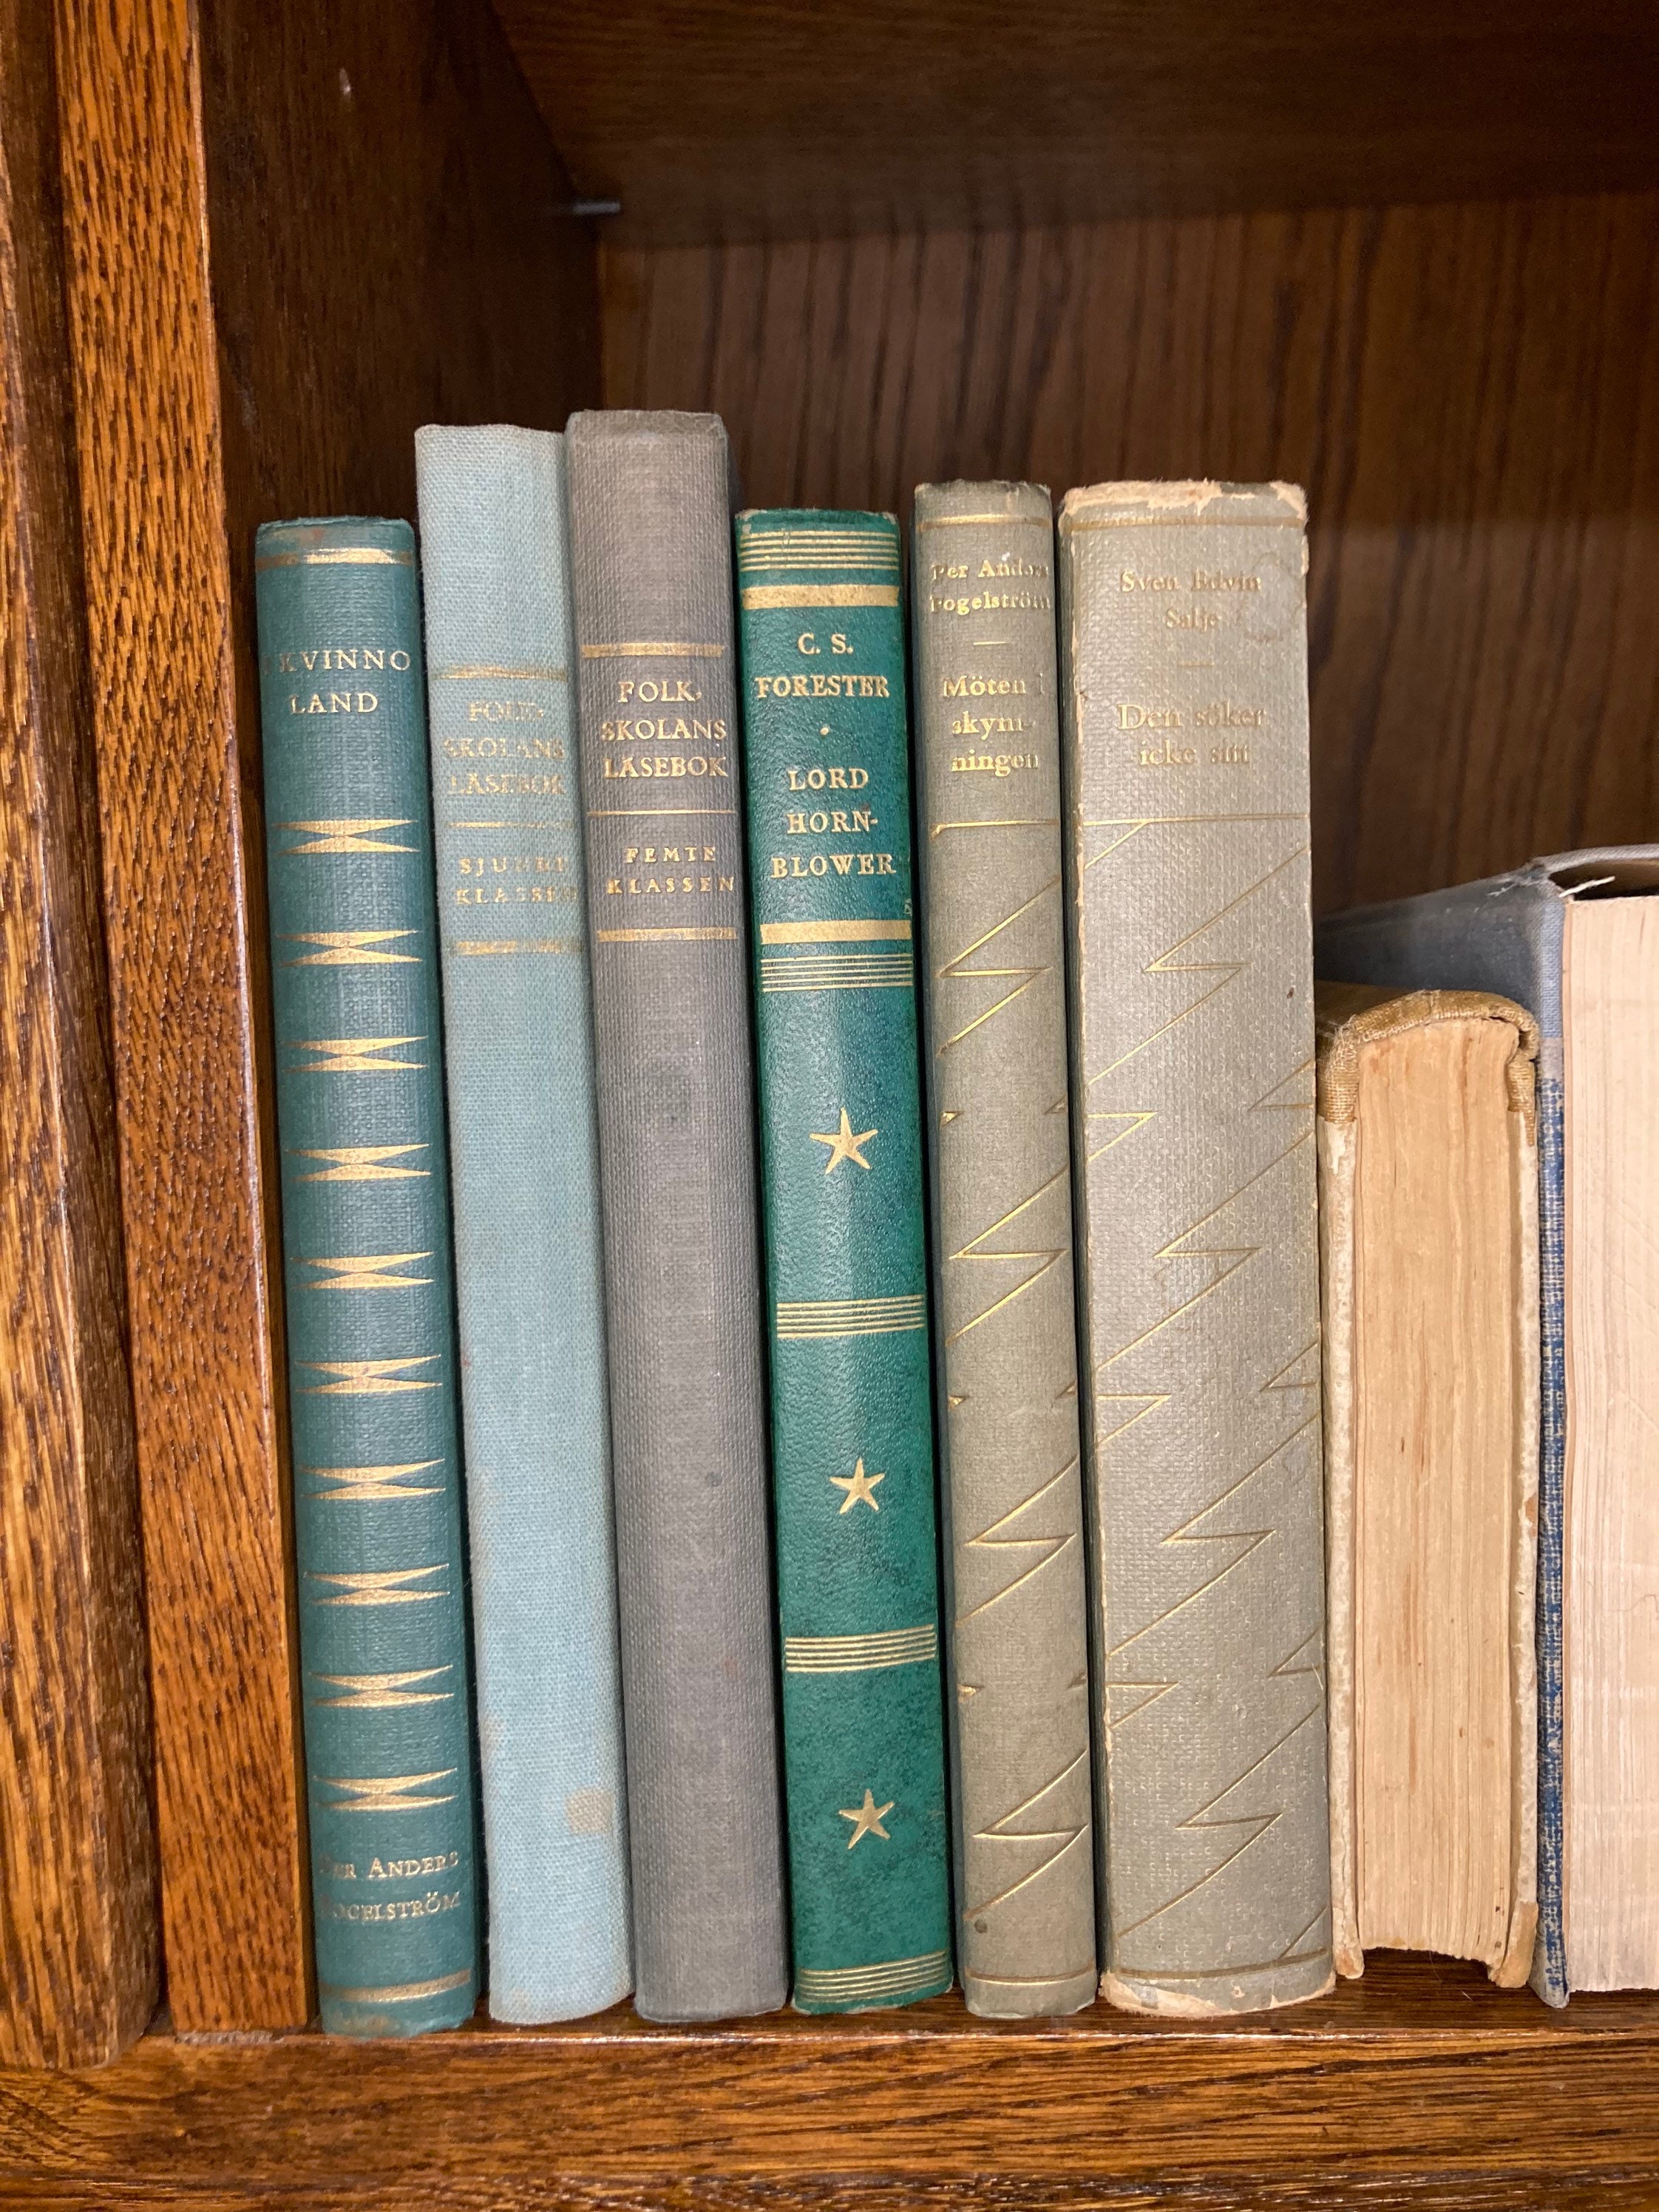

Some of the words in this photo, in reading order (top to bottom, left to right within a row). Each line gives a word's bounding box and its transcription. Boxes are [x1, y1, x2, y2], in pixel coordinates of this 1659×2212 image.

[1120, 569, 1178, 592] Sven
[798, 632, 821, 655] C.
[831, 633, 854, 655] S.
[755, 674, 890, 699] FORESTER
[943, 674, 1027, 697] Möten
[289, 693, 379, 713] LAND
[1117, 704, 1182, 730] Den
[601, 718, 727, 742] SKOLANS
[951, 748, 1039, 778] ningen
[1139, 739, 1197, 766] icke
[787, 767, 869, 791] LORD
[787, 810, 878, 834] HORN-
[625, 846, 716, 864] FEMTE
[770, 853, 897, 879] BLOWER
[606, 875, 735, 895] KLASSEN
